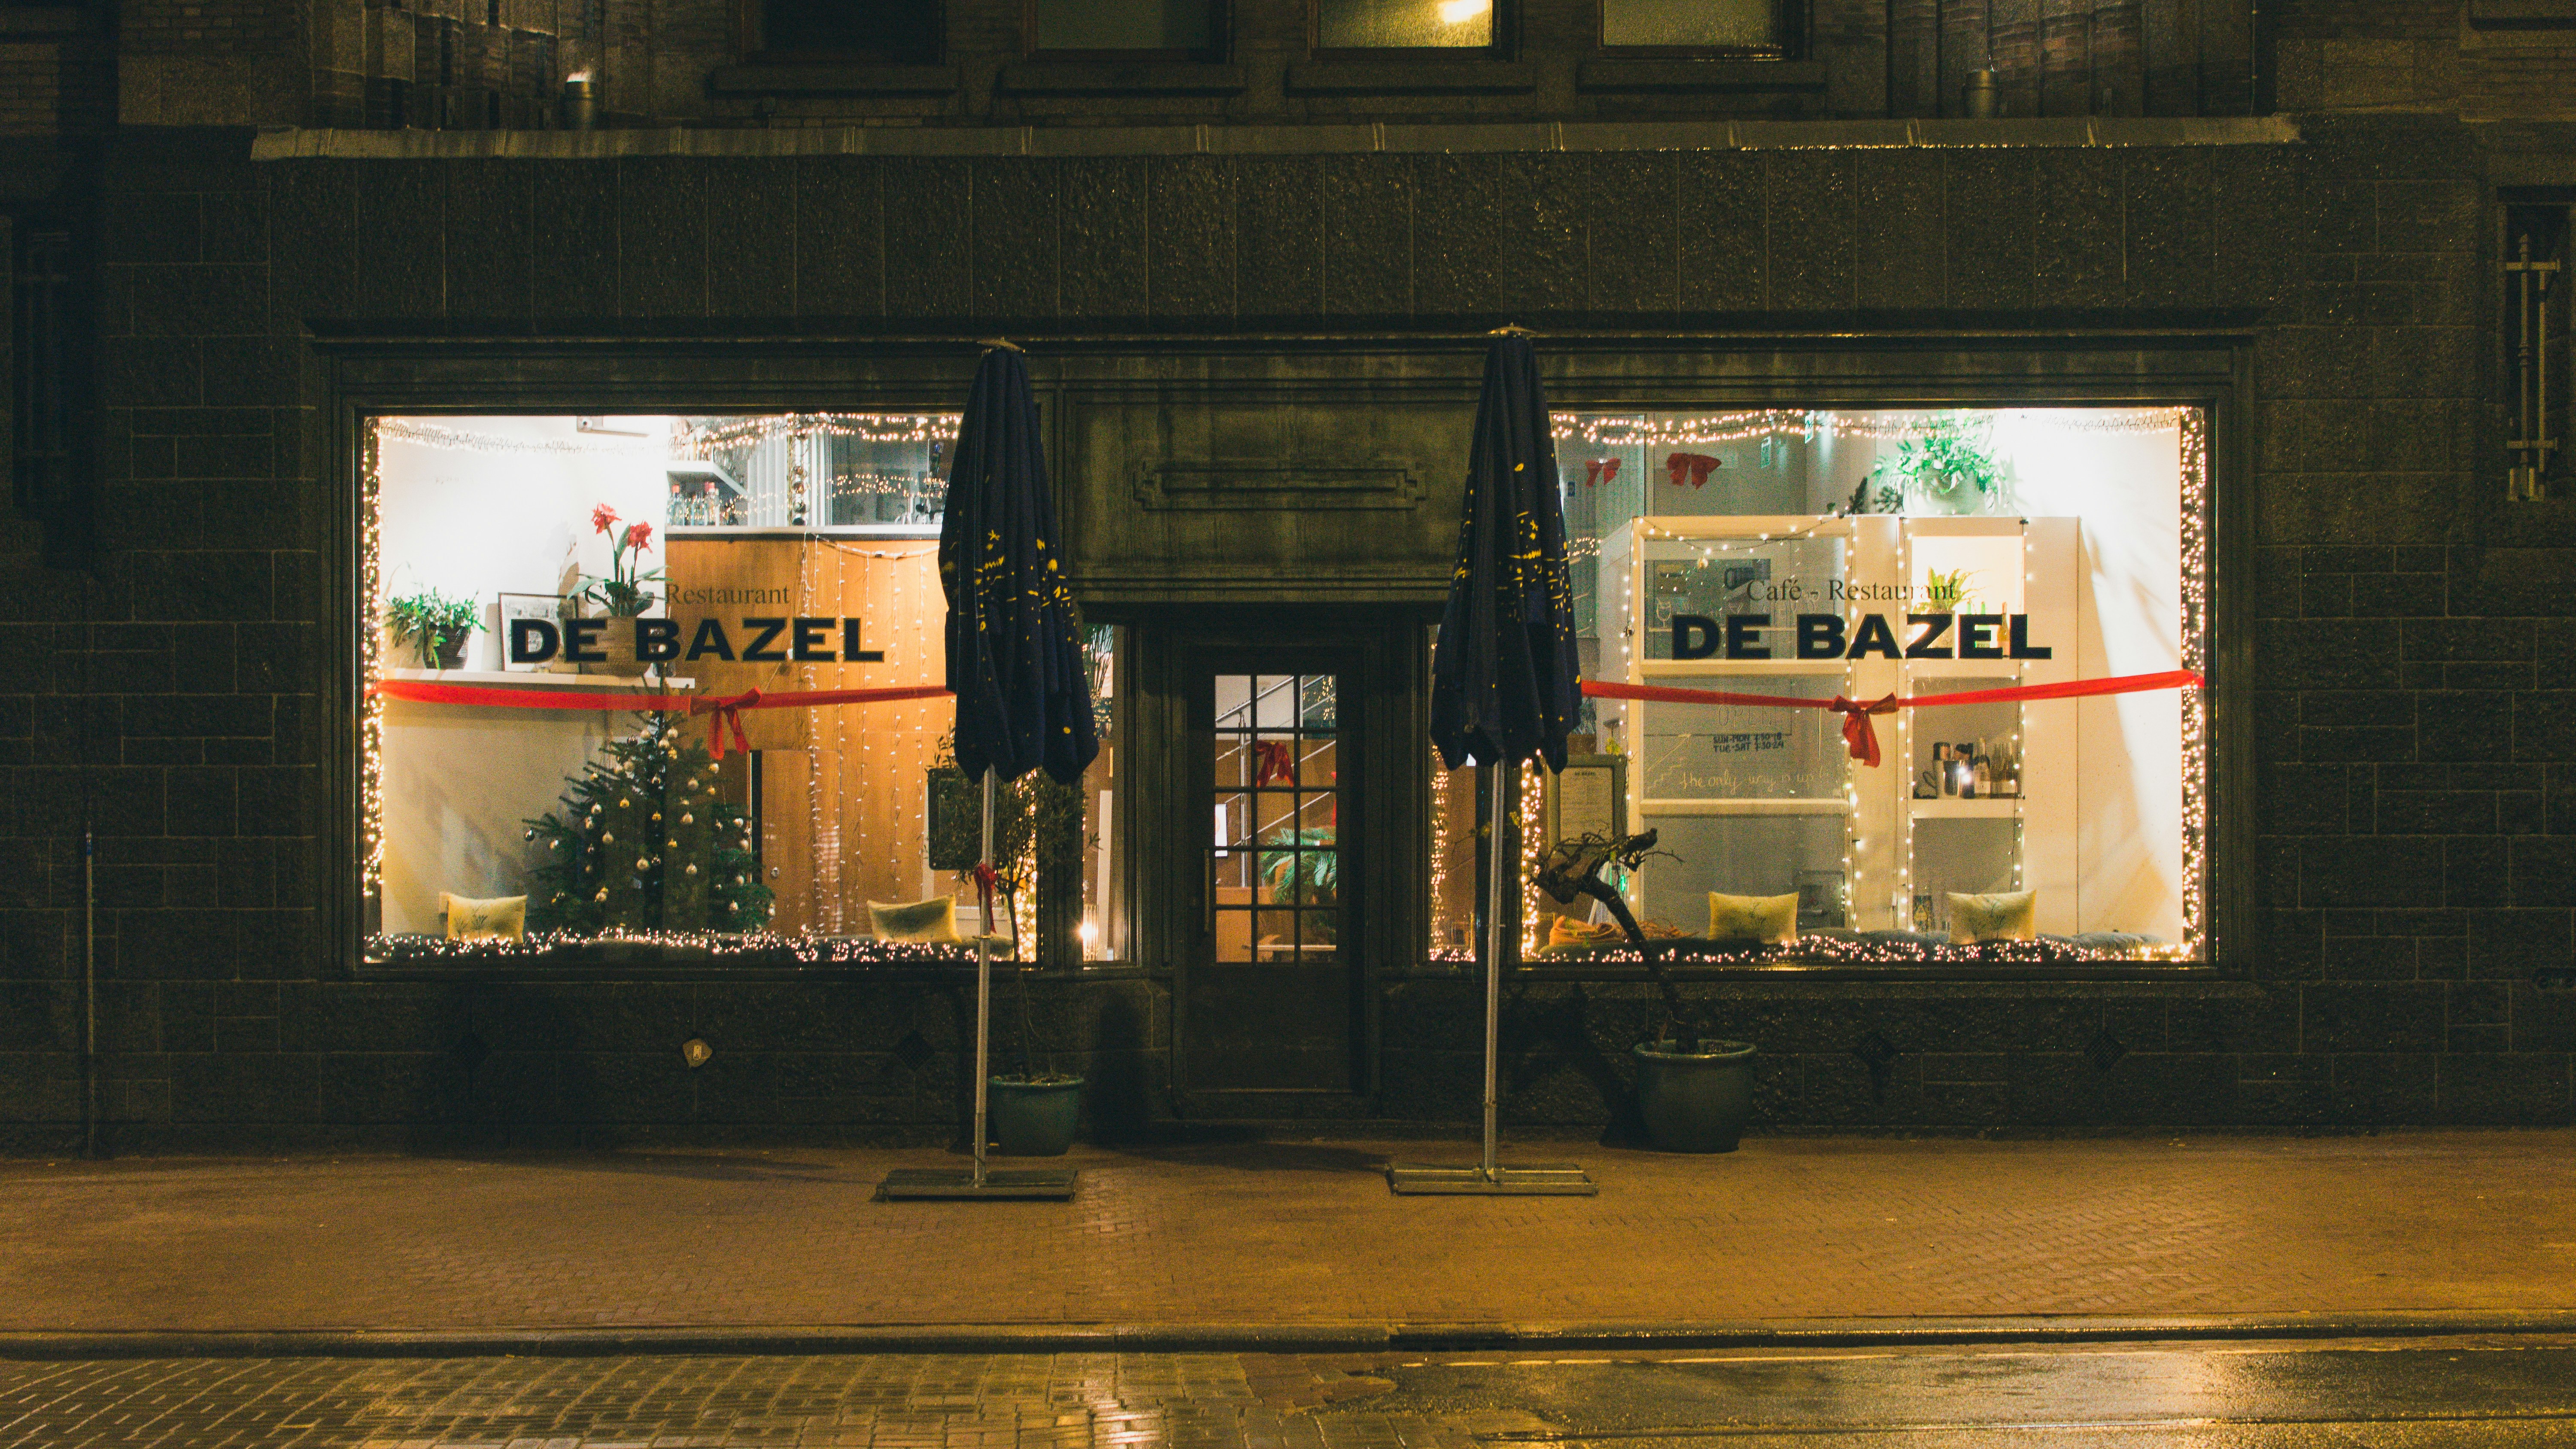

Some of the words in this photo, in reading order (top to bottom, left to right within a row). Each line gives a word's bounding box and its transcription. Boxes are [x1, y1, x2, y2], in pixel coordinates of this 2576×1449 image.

[666, 583, 790, 604] Restaurant
[1747, 579, 1801, 601] Café
[1829, 580, 1956, 601] Restaurant
[511, 619, 608, 663] DE
[635, 617, 884, 663] BAZEL
[1672, 614, 1771, 659] DE
[1796, 614, 2052, 659] BAZEL
[1708, 769, 1742, 795] only
